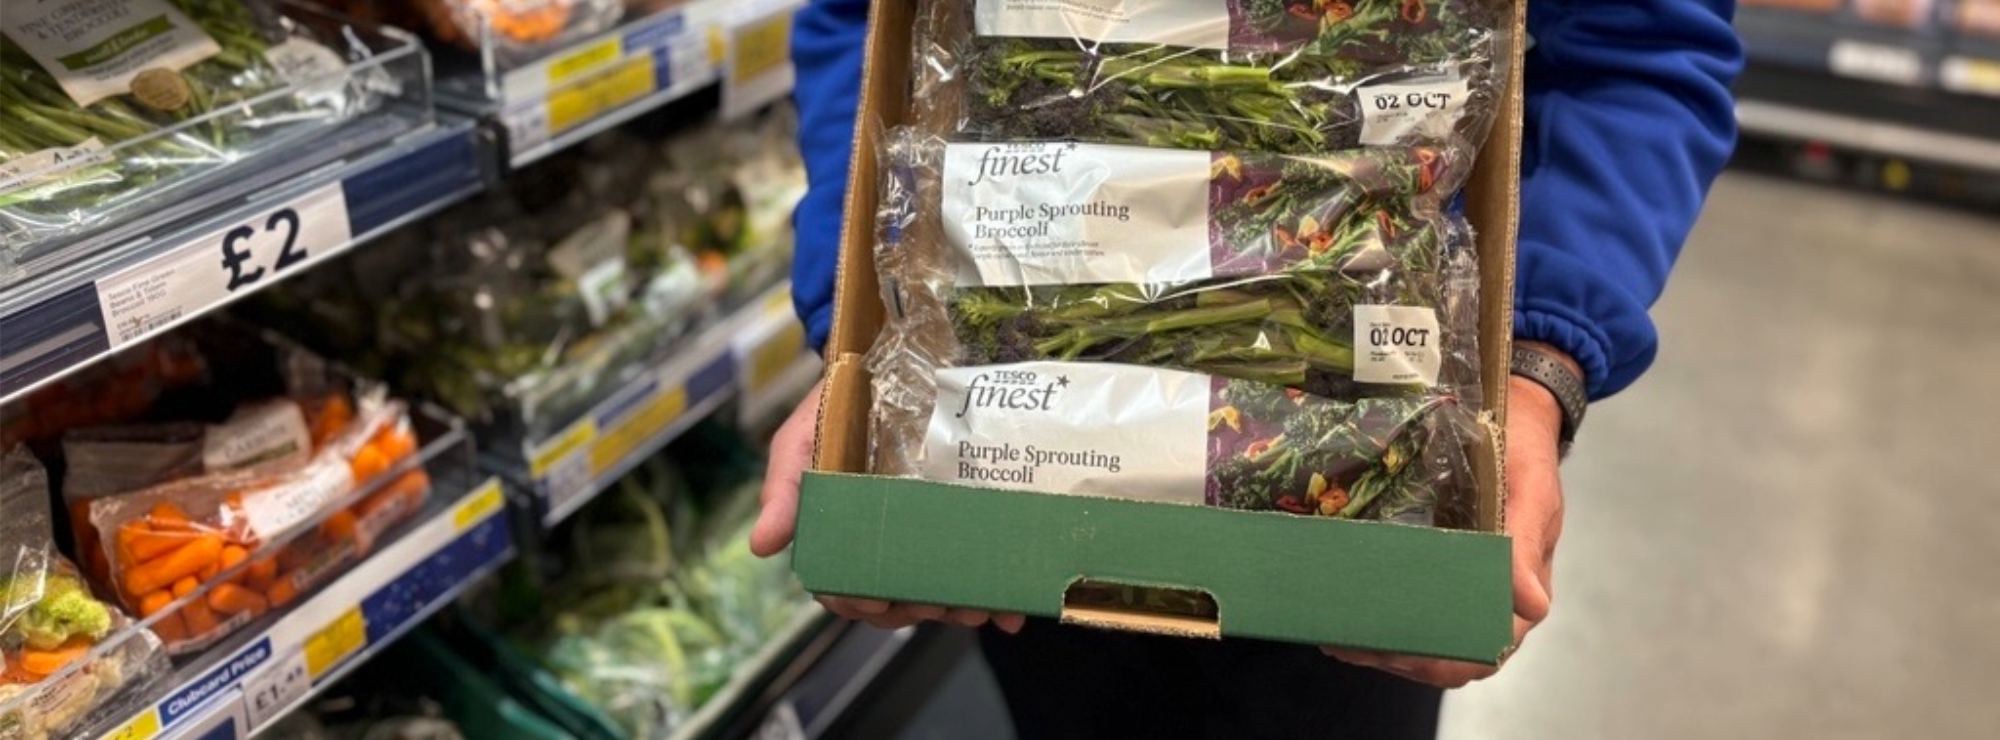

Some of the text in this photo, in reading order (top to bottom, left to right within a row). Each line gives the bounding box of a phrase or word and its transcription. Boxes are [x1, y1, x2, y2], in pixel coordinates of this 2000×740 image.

[1375, 92, 1451, 110] 02 OCT
[968, 146, 1066, 186] finest
[976, 201, 1130, 225] Purple Sprouting
[975, 221, 1049, 239] Broccoli
[222, 207, 308, 291] £2
[1392, 327, 1430, 347] OCT
[993, 370, 1038, 384] TESCO
[955, 374, 1058, 418] finest
[958, 441, 1121, 473] Purple Sprouting
[957, 461, 1034, 483] Broccoli
[168, 647, 267, 716] Clubcard Price
